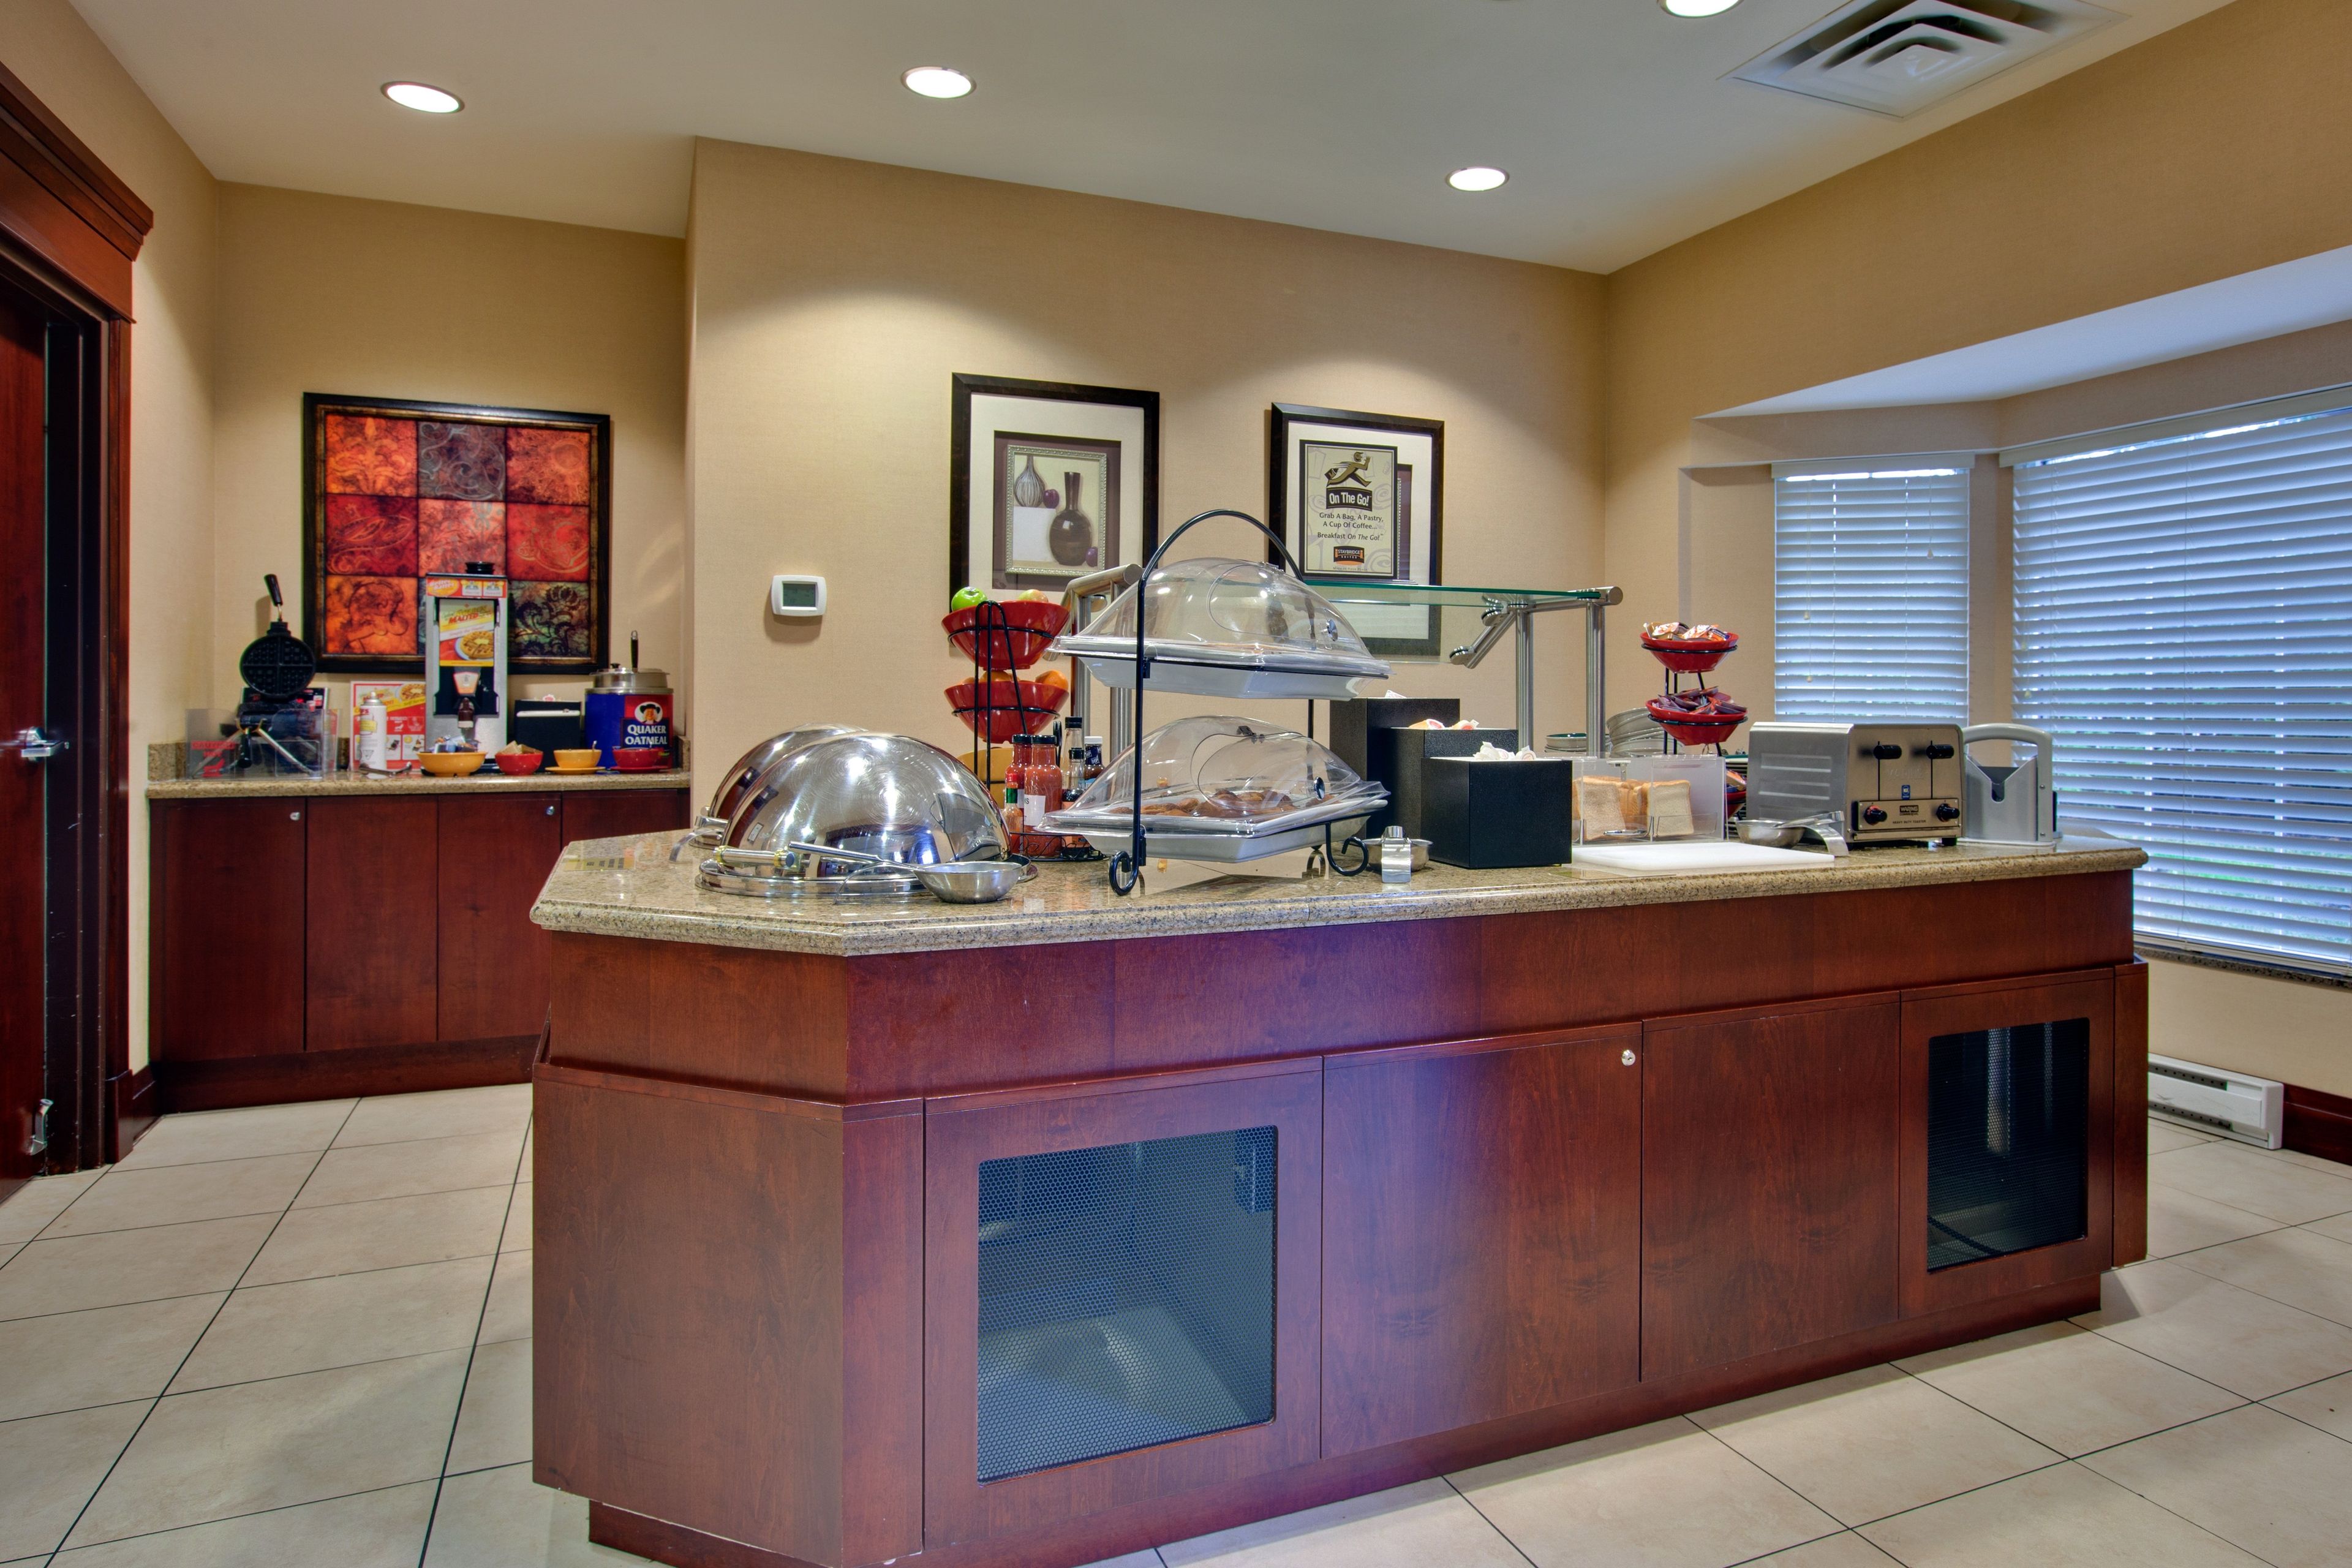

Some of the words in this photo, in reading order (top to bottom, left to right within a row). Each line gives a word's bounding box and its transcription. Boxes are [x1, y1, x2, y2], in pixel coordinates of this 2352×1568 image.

[1329, 492, 1340, 504] On
[1341, 492, 1355, 503] The
[448, 612, 479, 624] MALTED
[627, 724, 666, 735] QUAKER
[625, 736, 668, 745] OATMEAL
